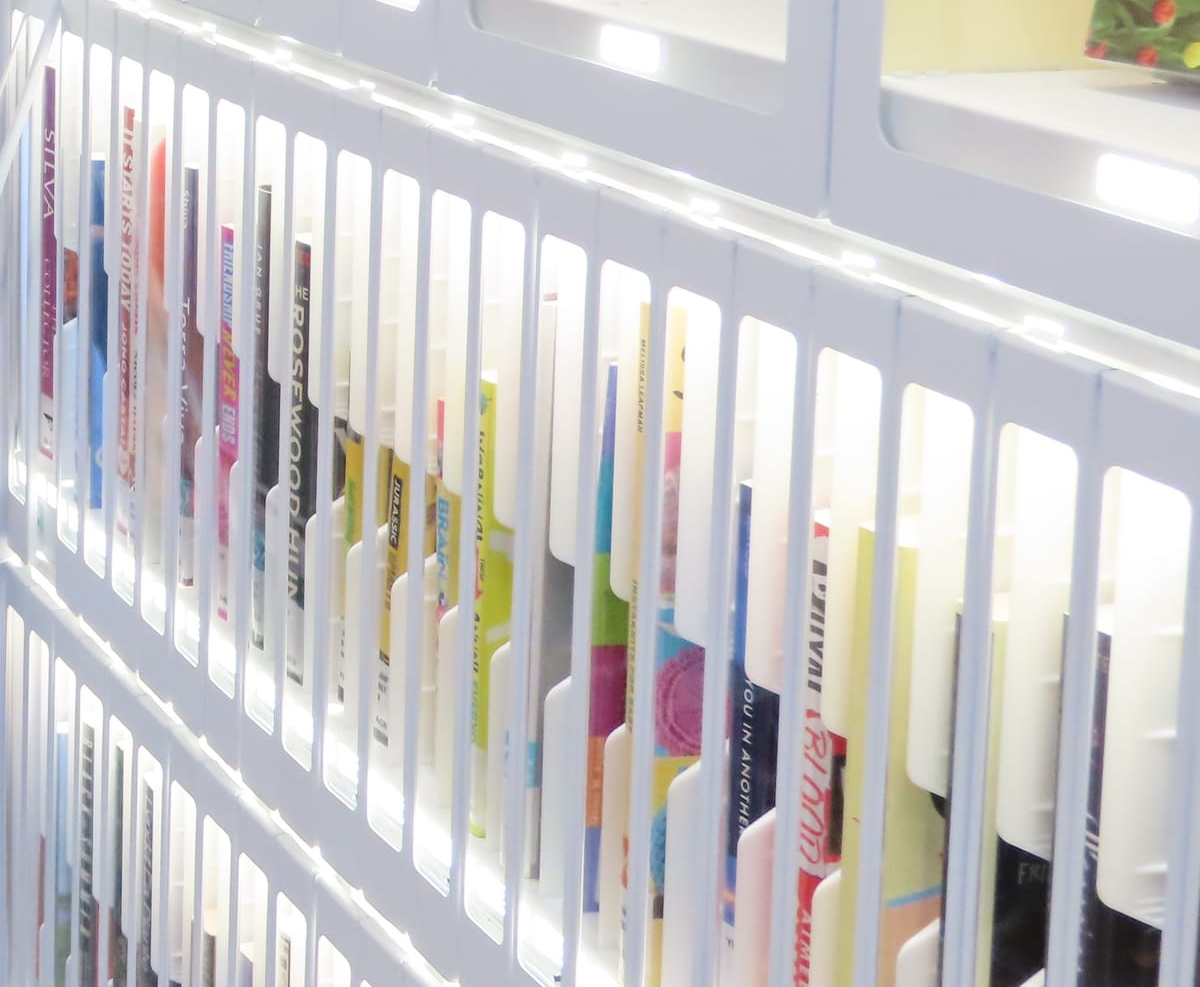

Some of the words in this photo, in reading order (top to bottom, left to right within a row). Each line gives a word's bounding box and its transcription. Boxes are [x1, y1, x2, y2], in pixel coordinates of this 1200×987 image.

[43, 128, 57, 219] SILVA
[121, 153, 134, 236] STARTS
[120, 241, 131, 311] TODAY
[222, 329, 236, 400] NEVER
[222, 404, 236, 446] ENDS
[289, 303, 304, 518] ROSEWOOD
[390, 478, 401, 545] JURASSIC
[287, 526, 300, 596] HUN
[743, 678, 753, 717] YOU
[741, 721, 753, 745] IN
